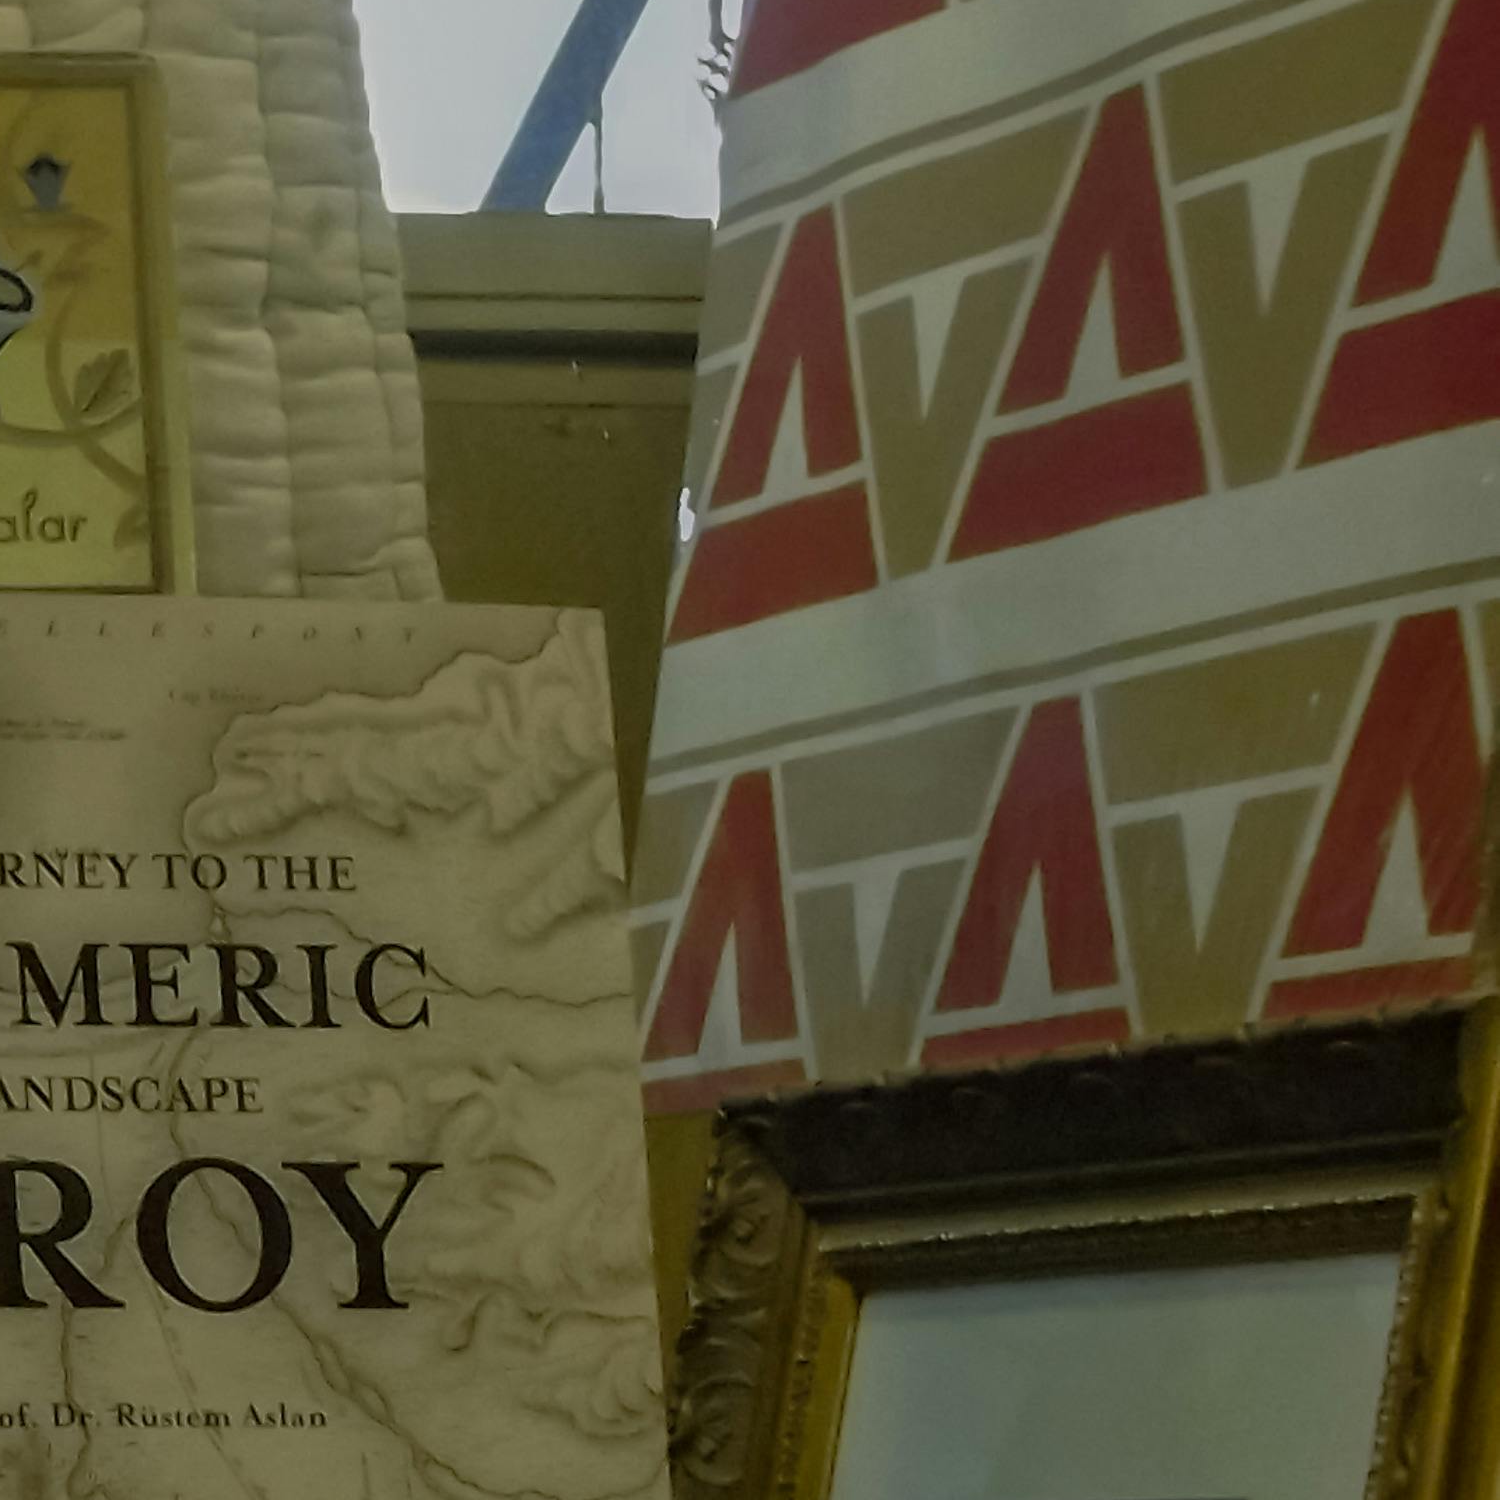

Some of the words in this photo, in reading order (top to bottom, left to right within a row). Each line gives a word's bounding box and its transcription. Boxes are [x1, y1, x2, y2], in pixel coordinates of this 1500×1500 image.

[151, 853, 229, 893] TO
[244, 854, 357, 893] THE
[52, 1402, 100, 1428] Dr.
[115, 1402, 231, 1428] Rüstem
[244, 1402, 328, 1428] Aslan
